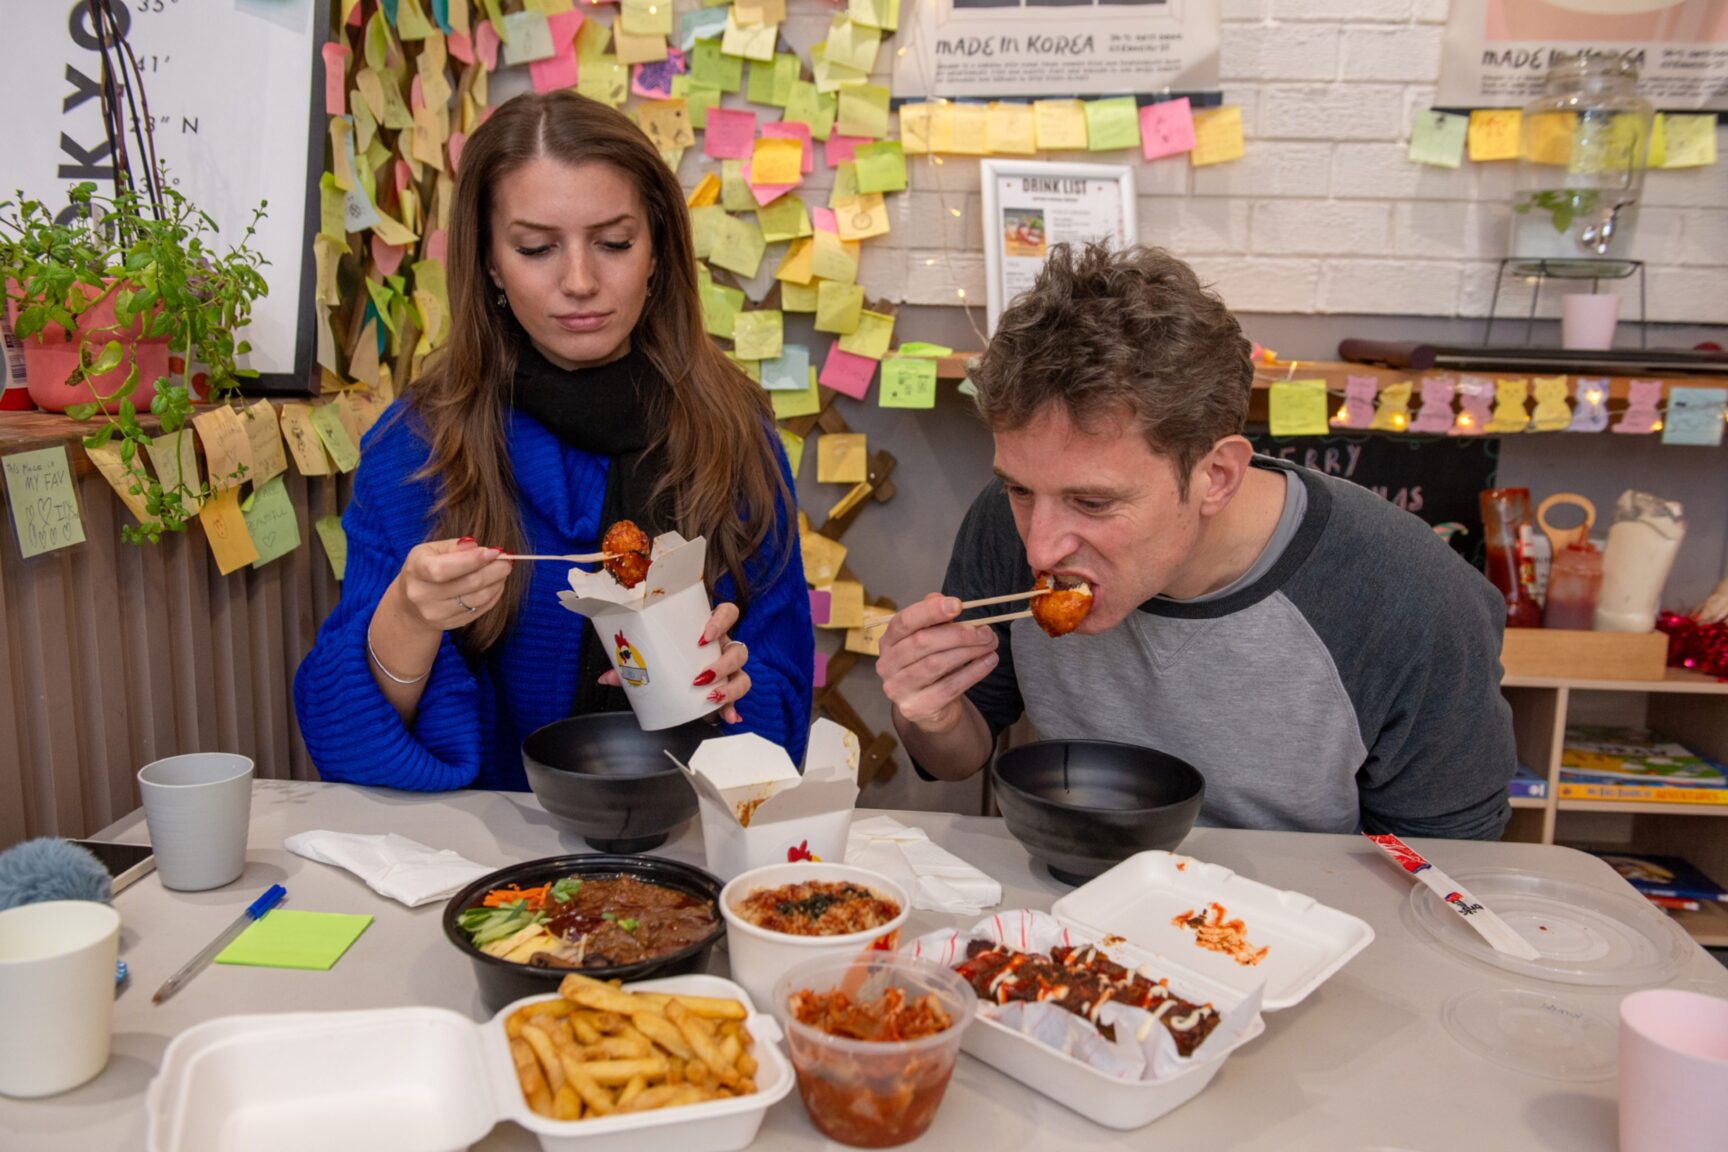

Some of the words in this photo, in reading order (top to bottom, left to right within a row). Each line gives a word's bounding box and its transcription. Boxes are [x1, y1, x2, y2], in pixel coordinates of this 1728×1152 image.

[1027, 34, 1095, 56] KOREA
[182, 116, 199, 134] N
[1022, 177, 1060, 193] DRINK
[1063, 179, 1087, 195] LIST
[44, 470, 66, 491] FAV
